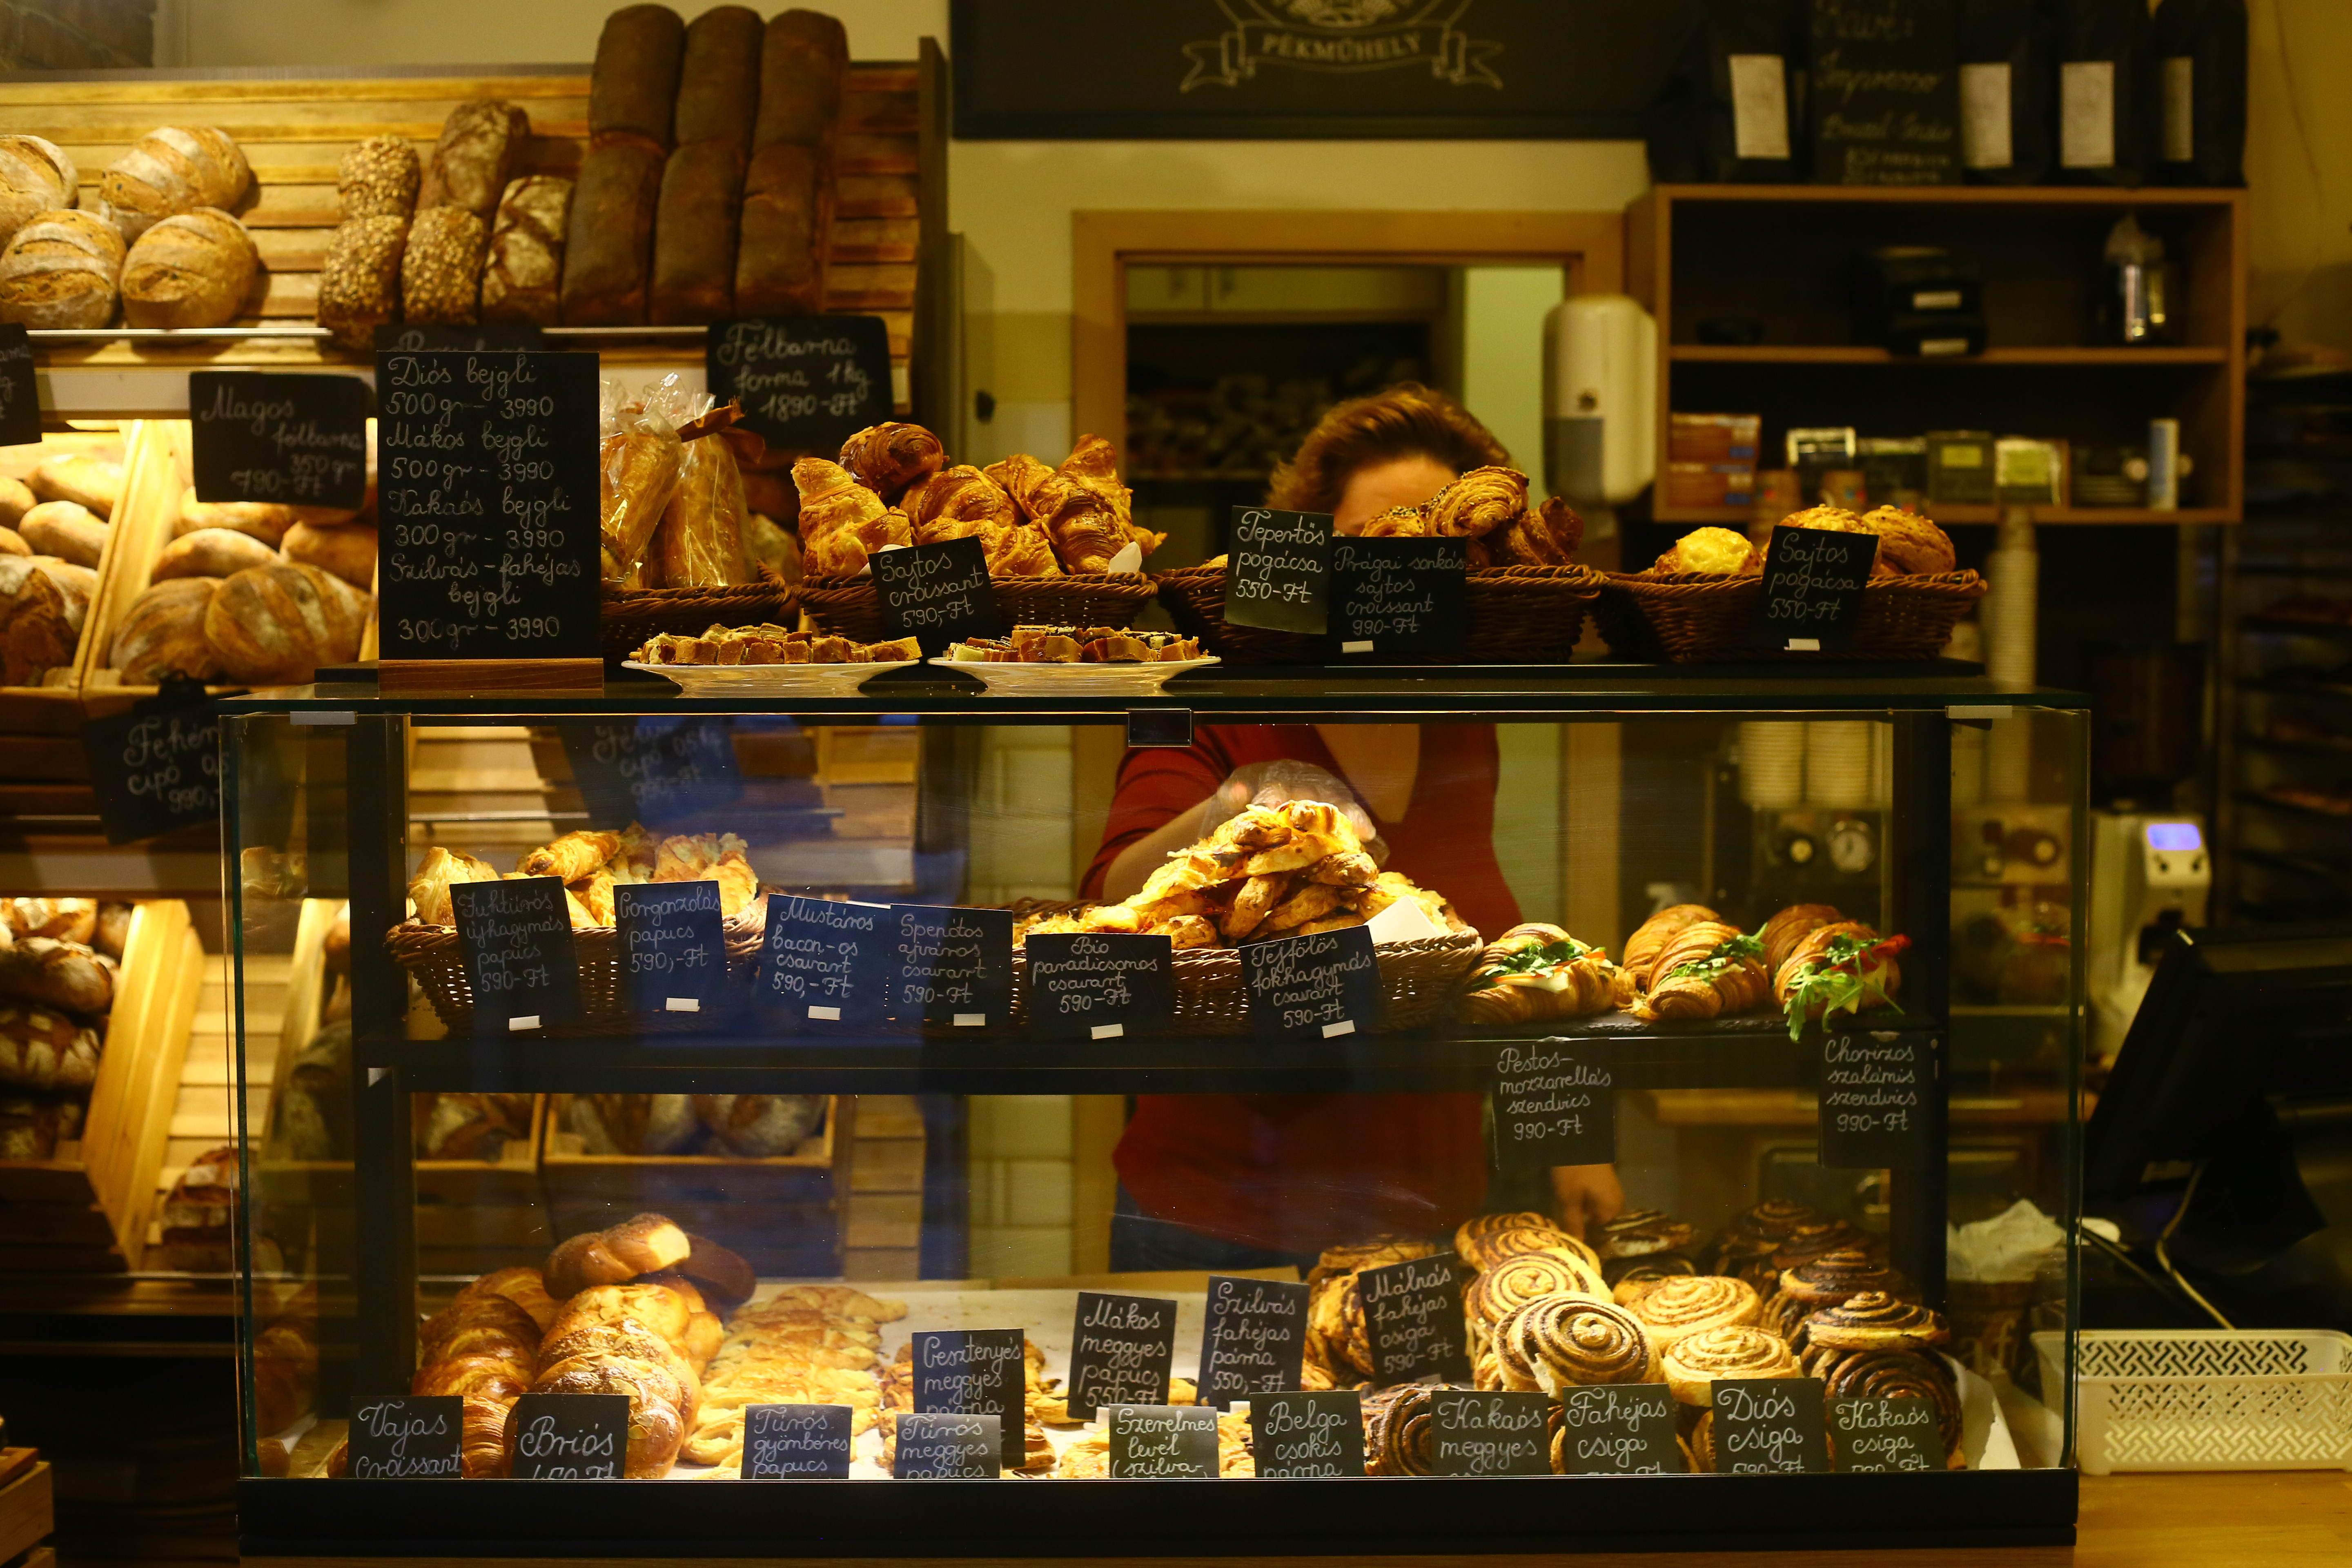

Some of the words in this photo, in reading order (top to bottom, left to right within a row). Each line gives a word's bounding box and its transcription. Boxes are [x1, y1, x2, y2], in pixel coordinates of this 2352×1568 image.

[388, 356, 452, 387] Diós
[466, 354, 537, 401] bejgli
[200, 384, 294, 436] Magos
[500, 396, 554, 419] 3990
[386, 421, 465, 450] Mákos
[482, 420, 549, 463] bejgli
[498, 460, 554, 482] 3990
[388, 489, 484, 516] Kakaós
[502, 485, 571, 530] bejgli
[506, 530, 564, 549] 3990
[1779, 532, 1848, 577] Sajtos
[880, 550, 952, 589] Sajtos
[1236, 550, 1323, 581] pogácsa
[1334, 546, 1401, 581] Prágai
[1408, 547, 1466, 570] sonkás
[448, 581, 521, 618] bejgli
[889, 564, 984, 606] croissant
[1356, 575, 1415, 603] sajtos
[1769, 568, 1860, 599] pogácsa
[1346, 593, 1434, 615] croissant
[506, 616, 560, 640] 3990
[780, 897, 874, 931] Mustáros
[900, 913, 984, 943] Spenótos
[467, 915, 564, 948] újhagymás
[630, 926, 694, 951] papucs
[1071, 936, 1109, 955] Bio
[478, 944, 541, 976] papucs
[776, 956, 852, 974] csavart
[902, 958, 987, 979] csavart
[1251, 935, 1338, 973] Tejfölös
[1033, 956, 1158, 986] paradicsomos
[1048, 971, 1126, 991] csavart
[1252, 951, 1372, 997] fokhagymás
[1273, 976, 1344, 1006] csavart
[1825, 1036, 1915, 1063] Chorizos
[1500, 1065, 1611, 1095] mozzarellás
[1828, 1064, 1915, 1084] szalámis
[1214, 1282, 1296, 1315] Szilvás
[1366, 1264, 1452, 1303] Málnás
[1083, 1298, 1160, 1330] Mákos
[1372, 1294, 1448, 1331] fahéjas
[1212, 1316, 1290, 1351] fahéjas
[1380, 1324, 1436, 1352] csiga
[923, 1334, 1021, 1375] Gesztenyés
[1080, 1335, 1167, 1368] meggyes
[1208, 1348, 1276, 1374] párna
[924, 1373, 1003, 1405] meggyes
[1078, 1364, 1161, 1394] papucs
[1437, 1397, 1542, 1431] Kakaós
[1566, 1387, 1667, 1432] Fahéjas
[1717, 1384, 1795, 1421] Diós
[1835, 1399, 1929, 1431] Kakaós
[358, 1401, 448, 1457] Vajas
[520, 1415, 613, 1457] Briós
[754, 1407, 828, 1434] Túrós
[901, 1415, 983, 1441] Túrós
[1116, 1408, 1215, 1434] Szerelmes
[1265, 1400, 1348, 1445] Belga
[902, 1443, 989, 1468] meggyes
[1128, 1433, 1181, 1459] levél
[1275, 1432, 1342, 1460] csokis
[1441, 1439, 1538, 1473] meggyes
[1578, 1432, 1648, 1468] csiga
[1728, 1424, 1804, 1463] csiga
[1853, 1434, 1915, 1463] csiga
[753, 1459, 828, 1479] papucs
